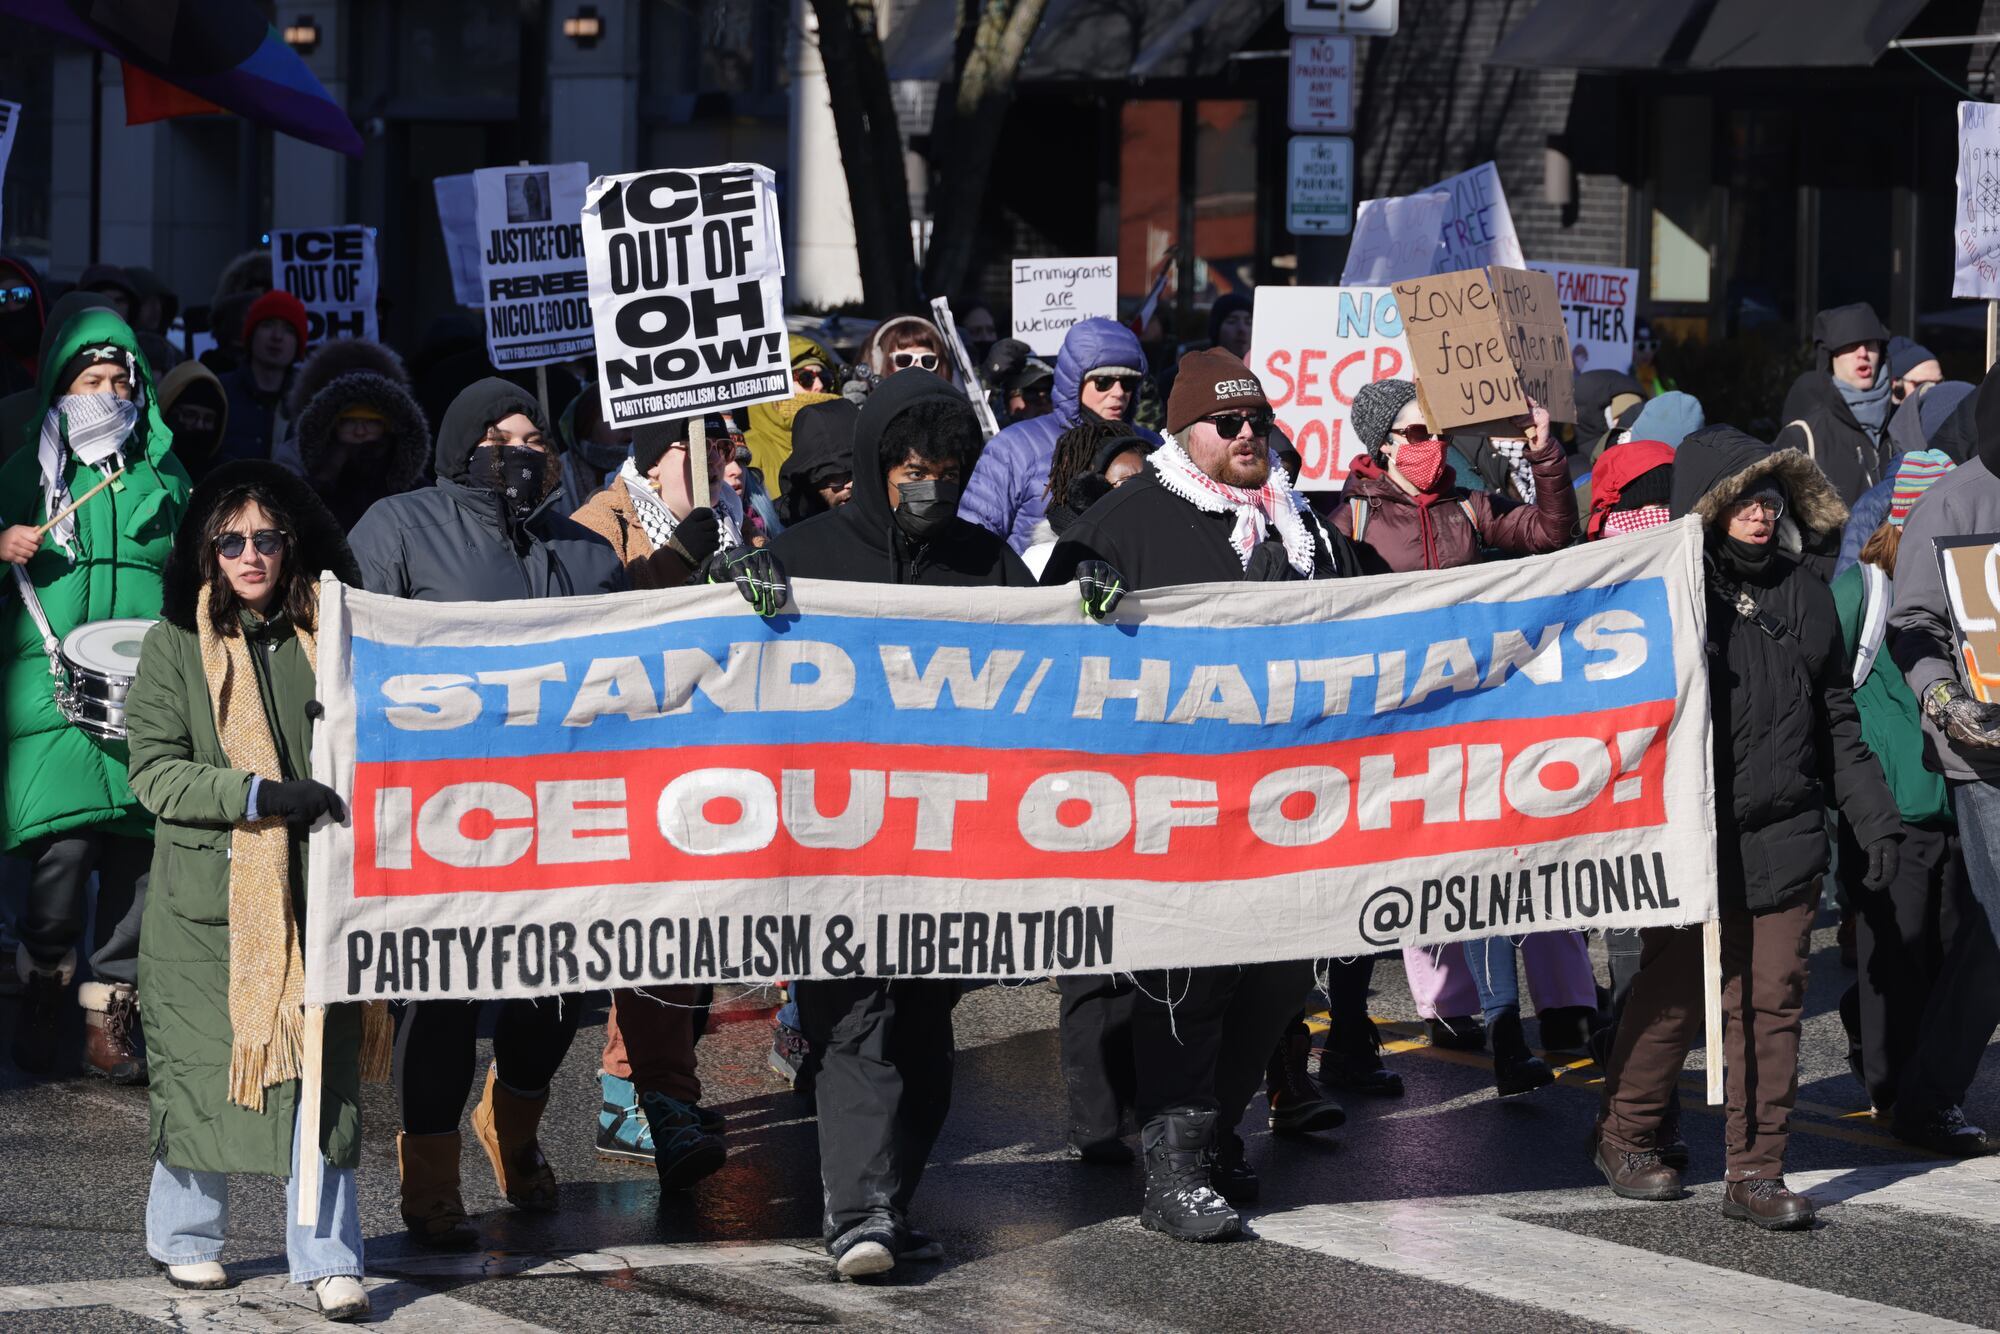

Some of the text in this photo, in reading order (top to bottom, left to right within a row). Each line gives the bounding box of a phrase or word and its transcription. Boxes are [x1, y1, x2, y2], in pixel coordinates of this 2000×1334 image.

[1297, 65, 1346, 78] PARKING
[1311, 46, 1334, 61] NO
[599, 168, 756, 230] ICE
[279, 231, 363, 262] ICE
[487, 228, 547, 265] JUSTICE
[1441, 208, 1496, 254] FREE
[608, 215, 753, 295] OUT OF
[1015, 264, 1112, 287] Immigrants
[285, 263, 361, 303] OUT OF
[489, 271, 588, 301] RENEE
[1045, 291, 1074, 307] are
[1503, 273, 1537, 316] the
[1557, 271, 1630, 306] FAMILIES
[491, 298, 593, 339] NICOLE GOOD
[616, 280, 764, 348] OH
[1337, 292, 1404, 338] NO
[605, 332, 781, 390] NOW!
[1551, 333, 1566, 362] in
[614, 375, 785, 417] PARTY FOR SOCIALISM & LIBERATION
[1461, 376, 1521, 415] your
[380, 609, 1648, 731] STAND W/ HAITIANS
[375, 726, 1660, 870] ICE OUT OF OHIO!
[1359, 852, 1680, 946] @PSLNATIONAL
[347, 905, 1114, 995] PARTY FOR SOCIALISM & LIBERATION
